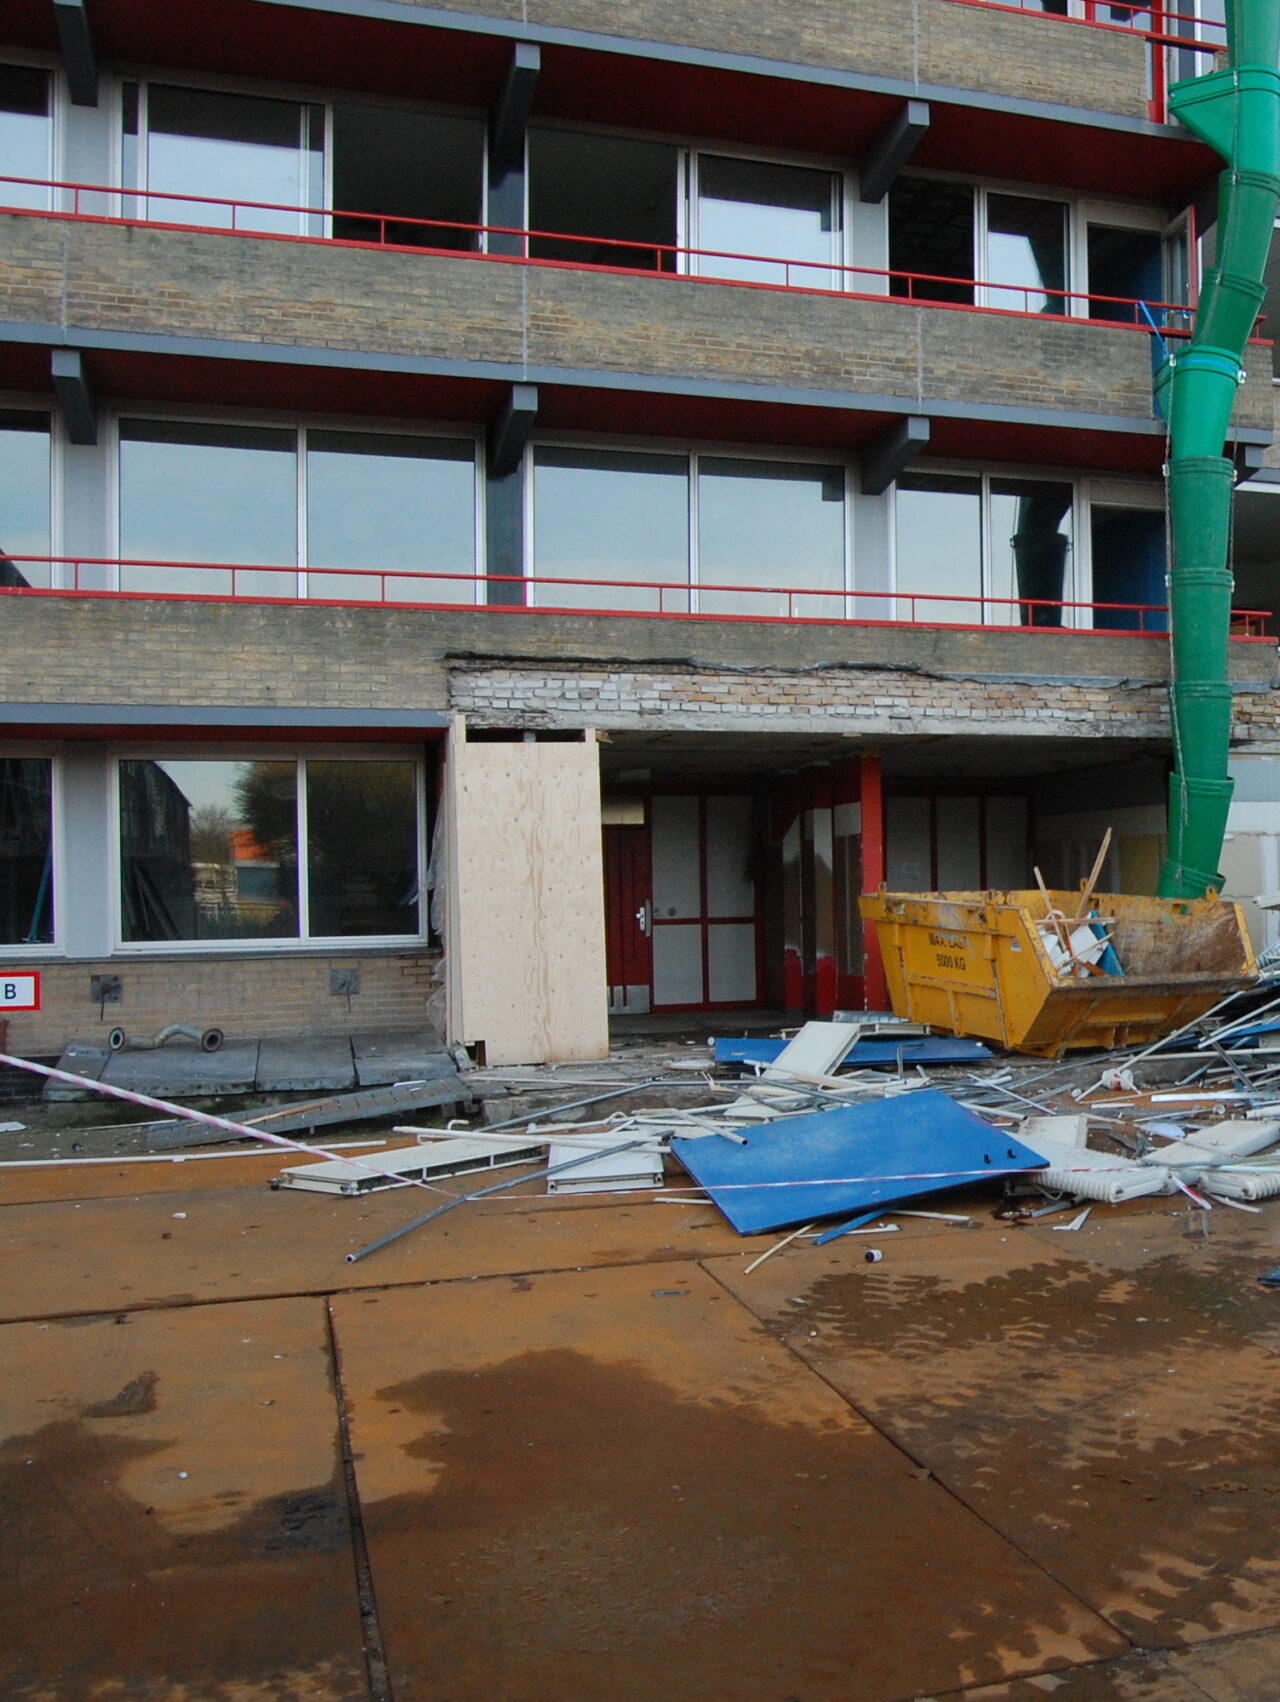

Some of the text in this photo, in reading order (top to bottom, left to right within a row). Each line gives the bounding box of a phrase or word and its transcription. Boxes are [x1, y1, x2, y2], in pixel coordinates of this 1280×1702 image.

[936, 953, 967, 971] 5000 KG
[4, 983, 17, 1000] B
